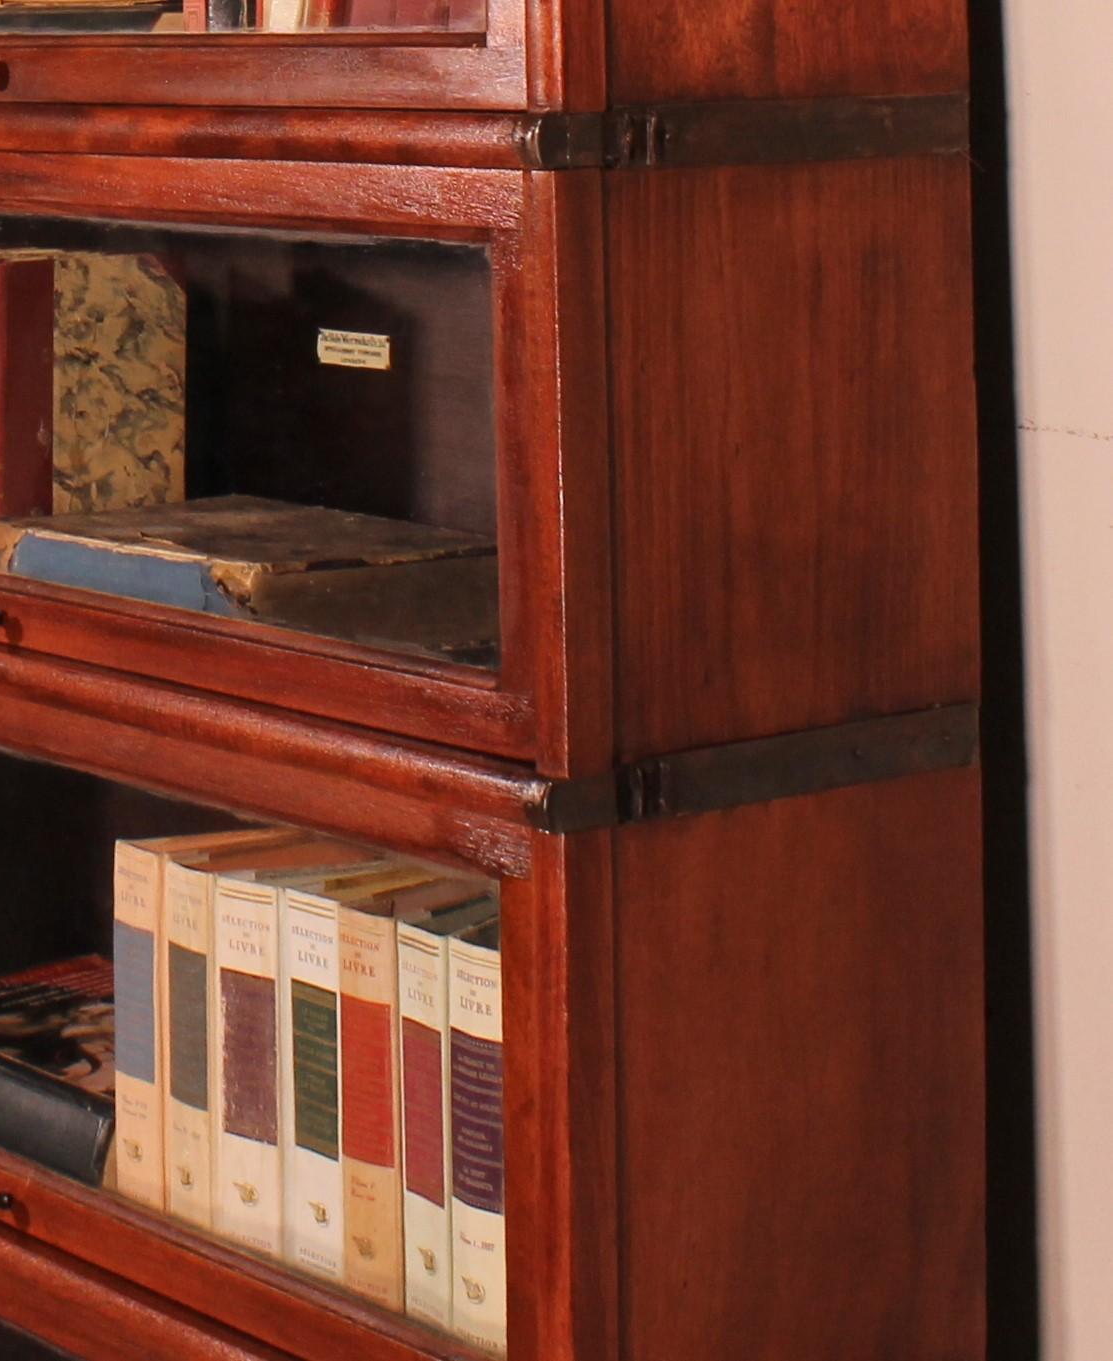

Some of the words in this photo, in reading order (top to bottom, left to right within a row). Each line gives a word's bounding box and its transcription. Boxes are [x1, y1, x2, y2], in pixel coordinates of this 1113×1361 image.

[297, 950, 329, 970] LIVRE
[342, 957, 376, 978] LIVRE
[459, 995, 493, 1017] LIVRE
